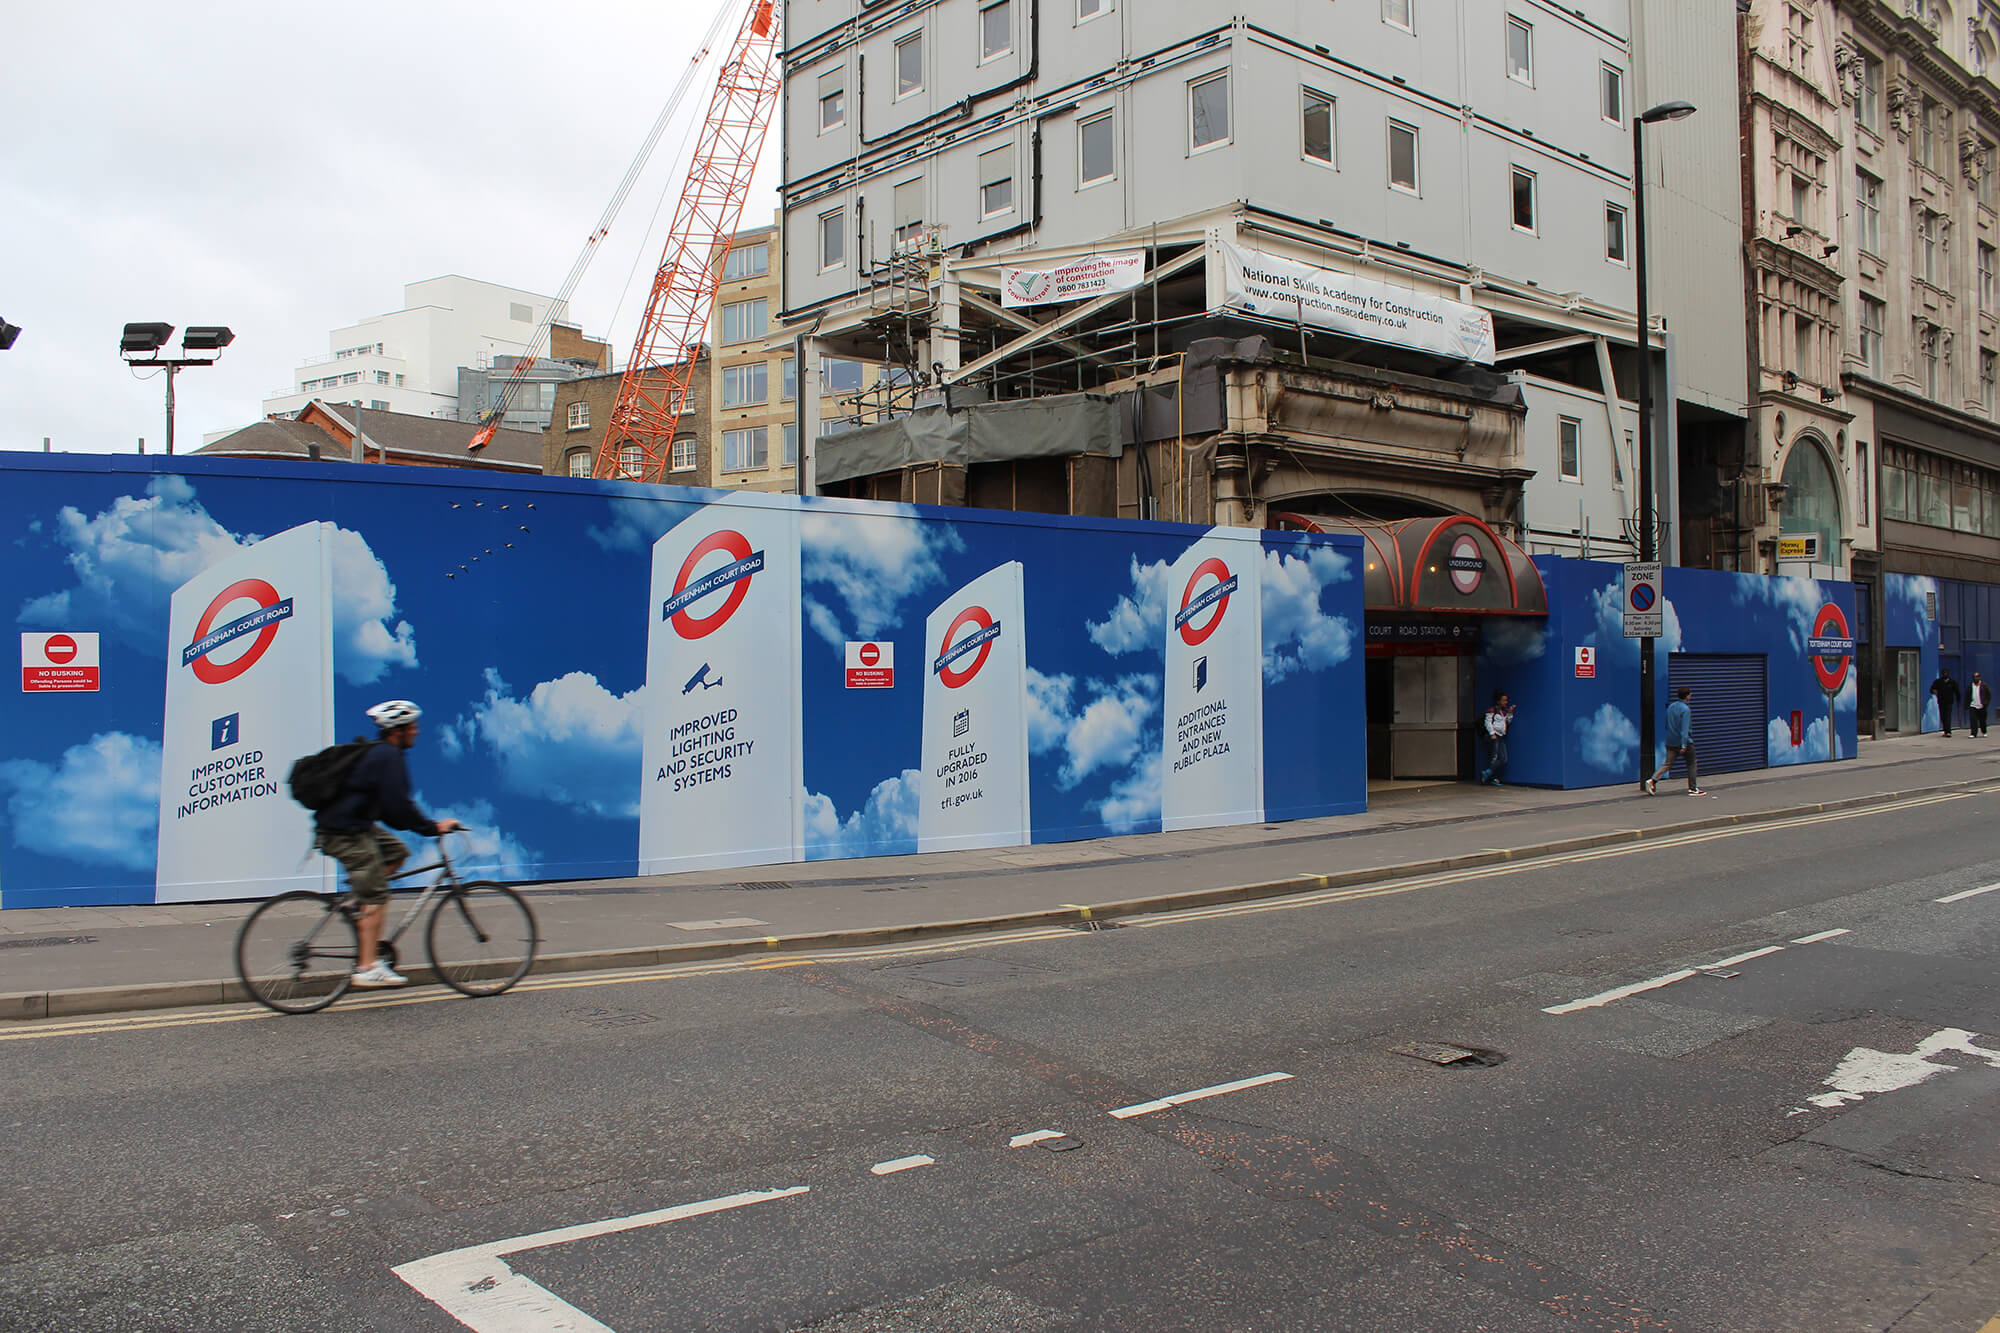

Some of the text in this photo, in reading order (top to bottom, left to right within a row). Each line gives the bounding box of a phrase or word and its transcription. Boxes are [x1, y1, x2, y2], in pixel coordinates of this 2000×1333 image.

[1055, 276, 1064, 284] of
[1066, 268, 1115, 282] construction
[1098, 260, 1111, 268] the
[1112, 258, 1139, 267] image
[1057, 284, 1076, 293] 0800
[1242, 266, 1443, 324] National Skills Academy for Construction
[1243, 285, 1408, 330] www.construction.nsacademy.co.uk
[1448, 560, 1482, 569] UNDERGROUND
[1625, 564, 1660, 572] Controlled
[1631, 572, 1655, 581] ZONE
[665, 558, 761, 613] TOTTENHAM COURT ROAD
[1176, 581, 1236, 624] TOTTENHAM COURT ROAD
[185, 605, 290, 659] TOTTENHAM COURT ROAD
[1369, 625, 1447, 636] COURT ROAD STATION
[936, 627, 999, 669] TOTTENHAM COURT ROAD
[670, 708, 738, 741] IMPROVED
[1177, 698, 1227, 729] ADDITIONAL
[1178, 713, 1226, 742] ENTRANCES
[221, 720, 231, 743] i
[672, 727, 735, 758] LIGHTING
[1181, 729, 1222, 754] AND NEW
[191, 750, 264, 781] IMPROVED
[656, 740, 754, 782] AND SECURITY
[936, 752, 988, 778] UPGRADED
[948, 742, 975, 760] FULLY
[1173, 742, 1230, 774] PUBLIC PLAZA
[188, 766, 266, 797] CUSTOMER
[673, 764, 732, 792] SYSTEMS
[945, 769, 978, 788] IN 2016
[177, 781, 277, 819] INFORMATION
[941, 788, 983, 810] tfl.gov.uk
